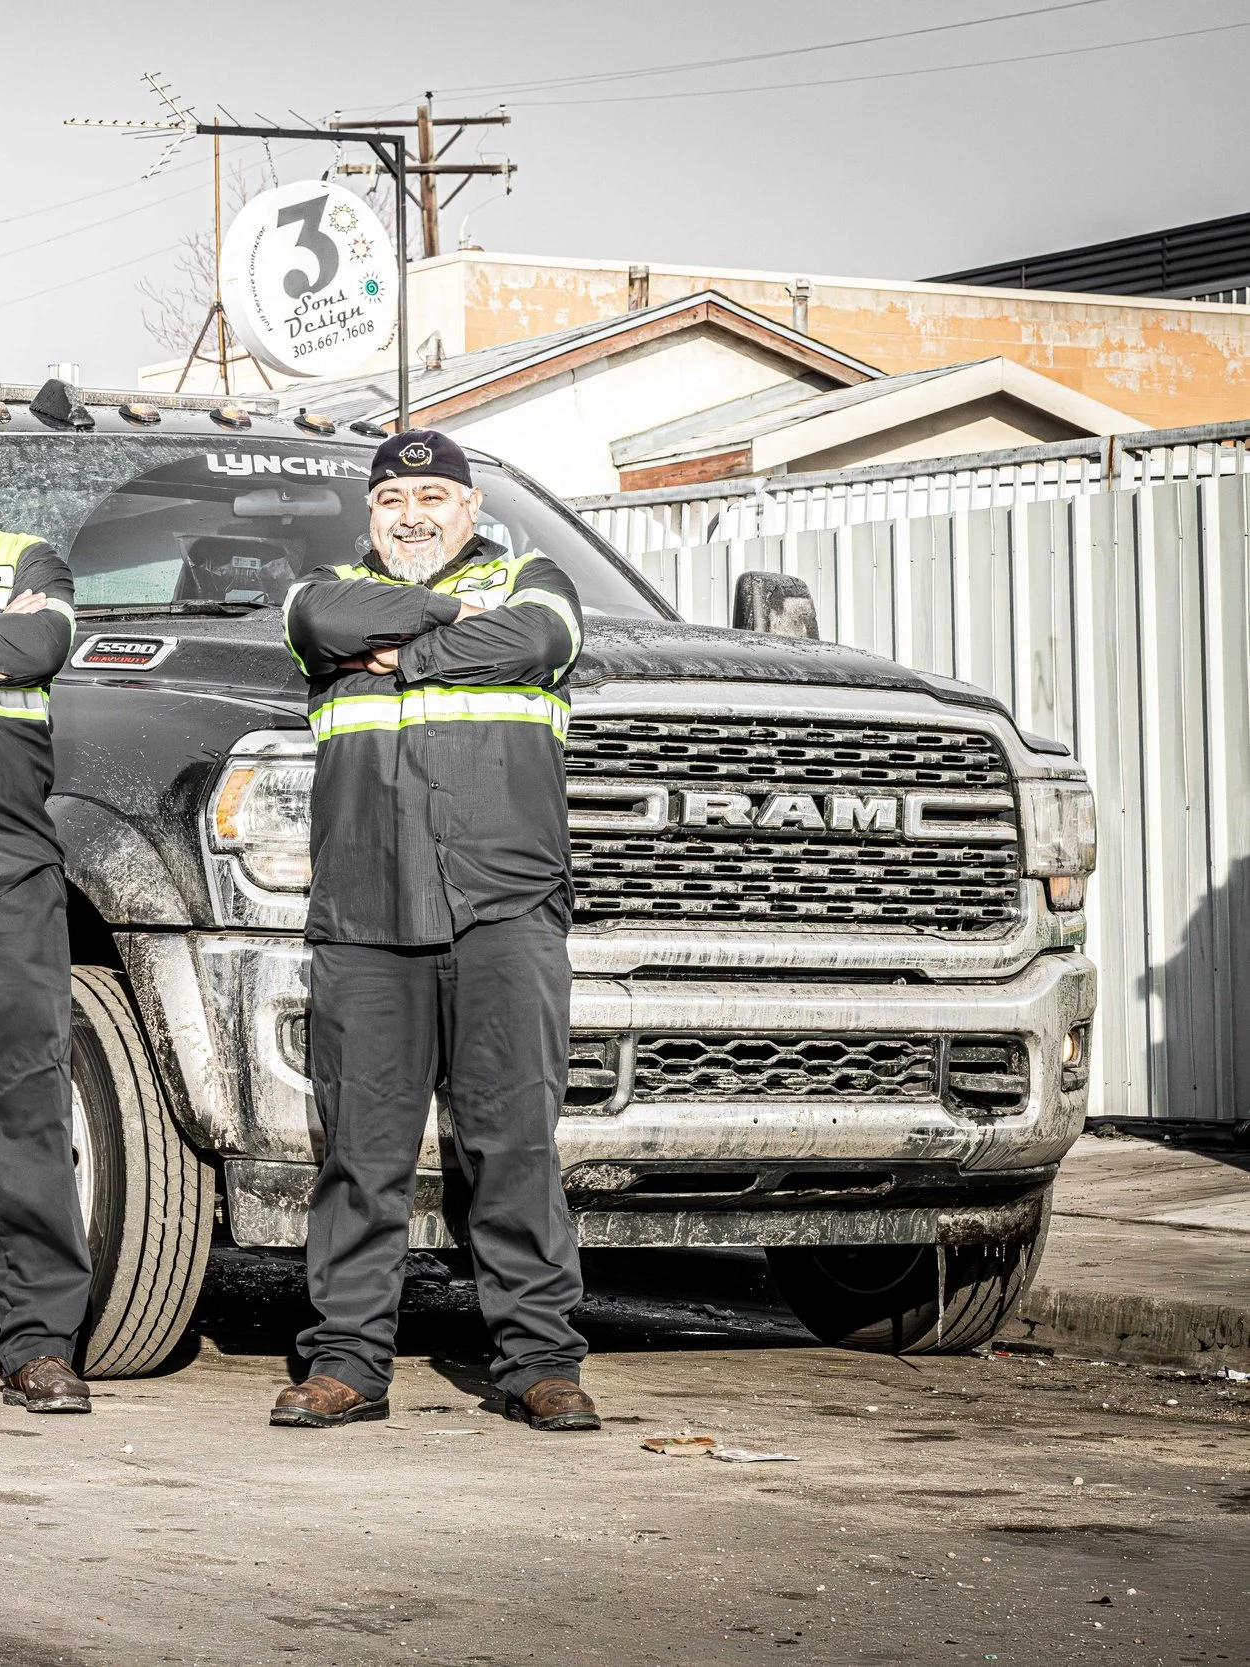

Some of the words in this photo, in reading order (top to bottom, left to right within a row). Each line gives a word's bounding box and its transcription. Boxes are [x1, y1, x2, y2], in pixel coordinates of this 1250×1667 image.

[248, 225, 266, 276] Contractor
[276, 193, 340, 299] 3
[250, 279, 264, 314] Service
[293, 289, 348, 316] Sons
[259, 315, 273, 332] Full
[284, 306, 365, 339] Design
[292, 320, 375, 359] 303.667.1608
[206, 453, 331, 476] LYNCH
[95, 642, 157, 654] 5500
[679, 790, 898, 831] RAM
